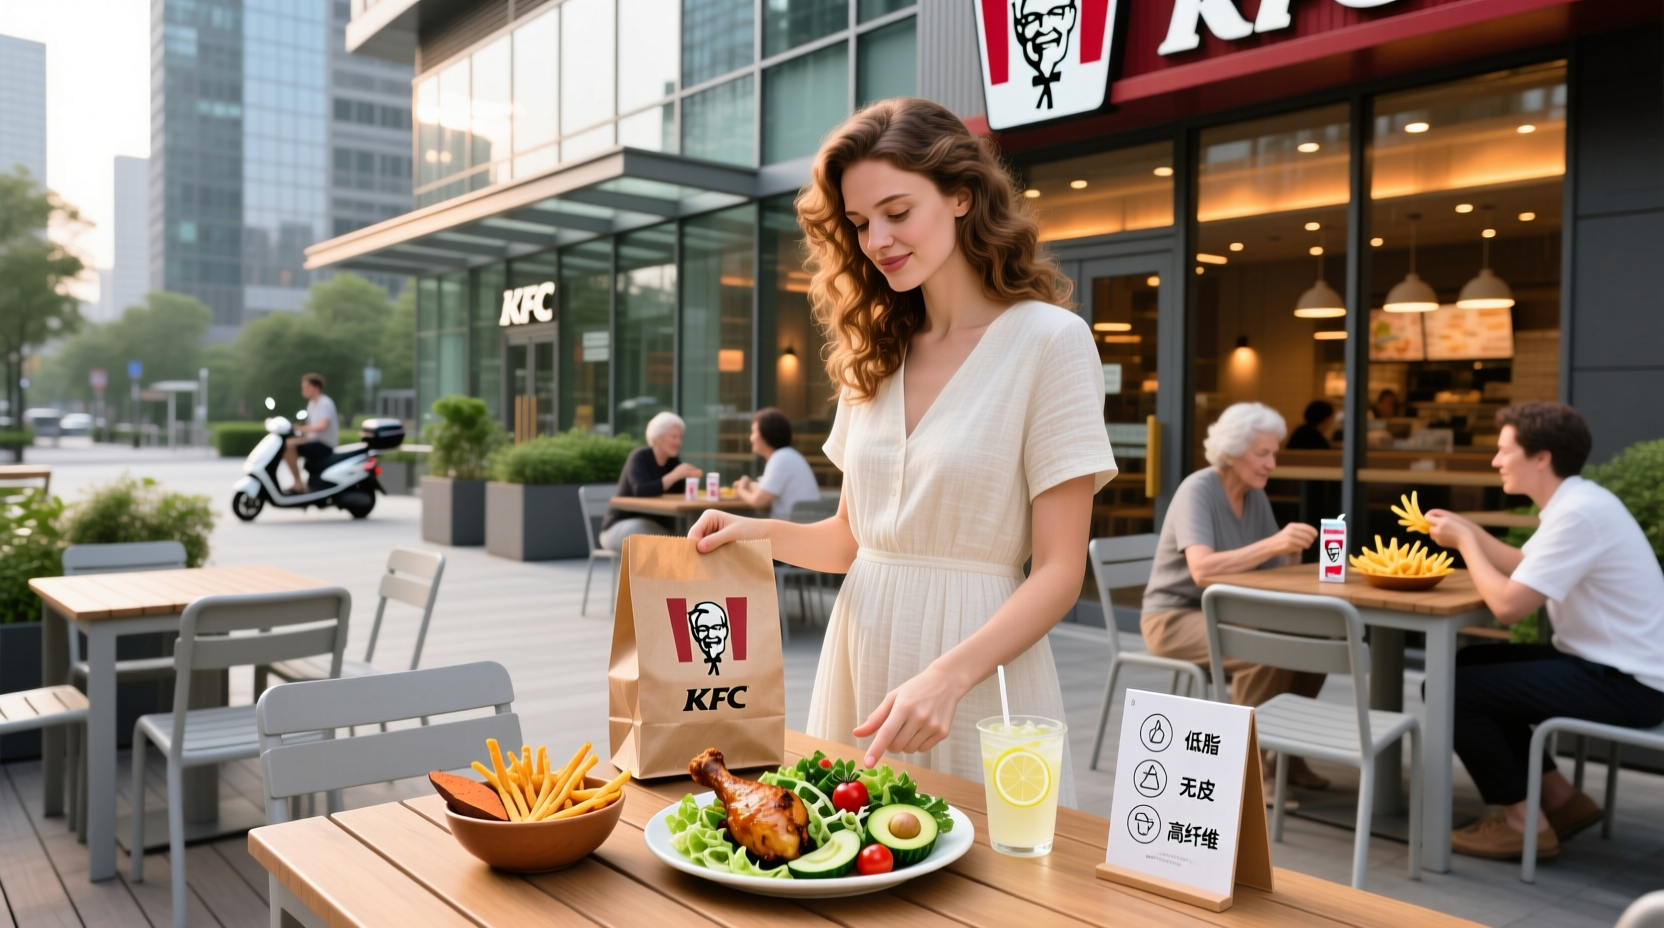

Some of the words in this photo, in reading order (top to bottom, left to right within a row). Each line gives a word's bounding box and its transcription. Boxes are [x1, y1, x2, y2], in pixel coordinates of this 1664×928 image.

[499, 281, 555, 326] KFC
[682, 685, 748, 712] KFC
[1184, 730, 1222, 756] 低脂
[1179, 776, 1216, 802] 无皮
[1167, 821, 1220, 851] 高纤维
